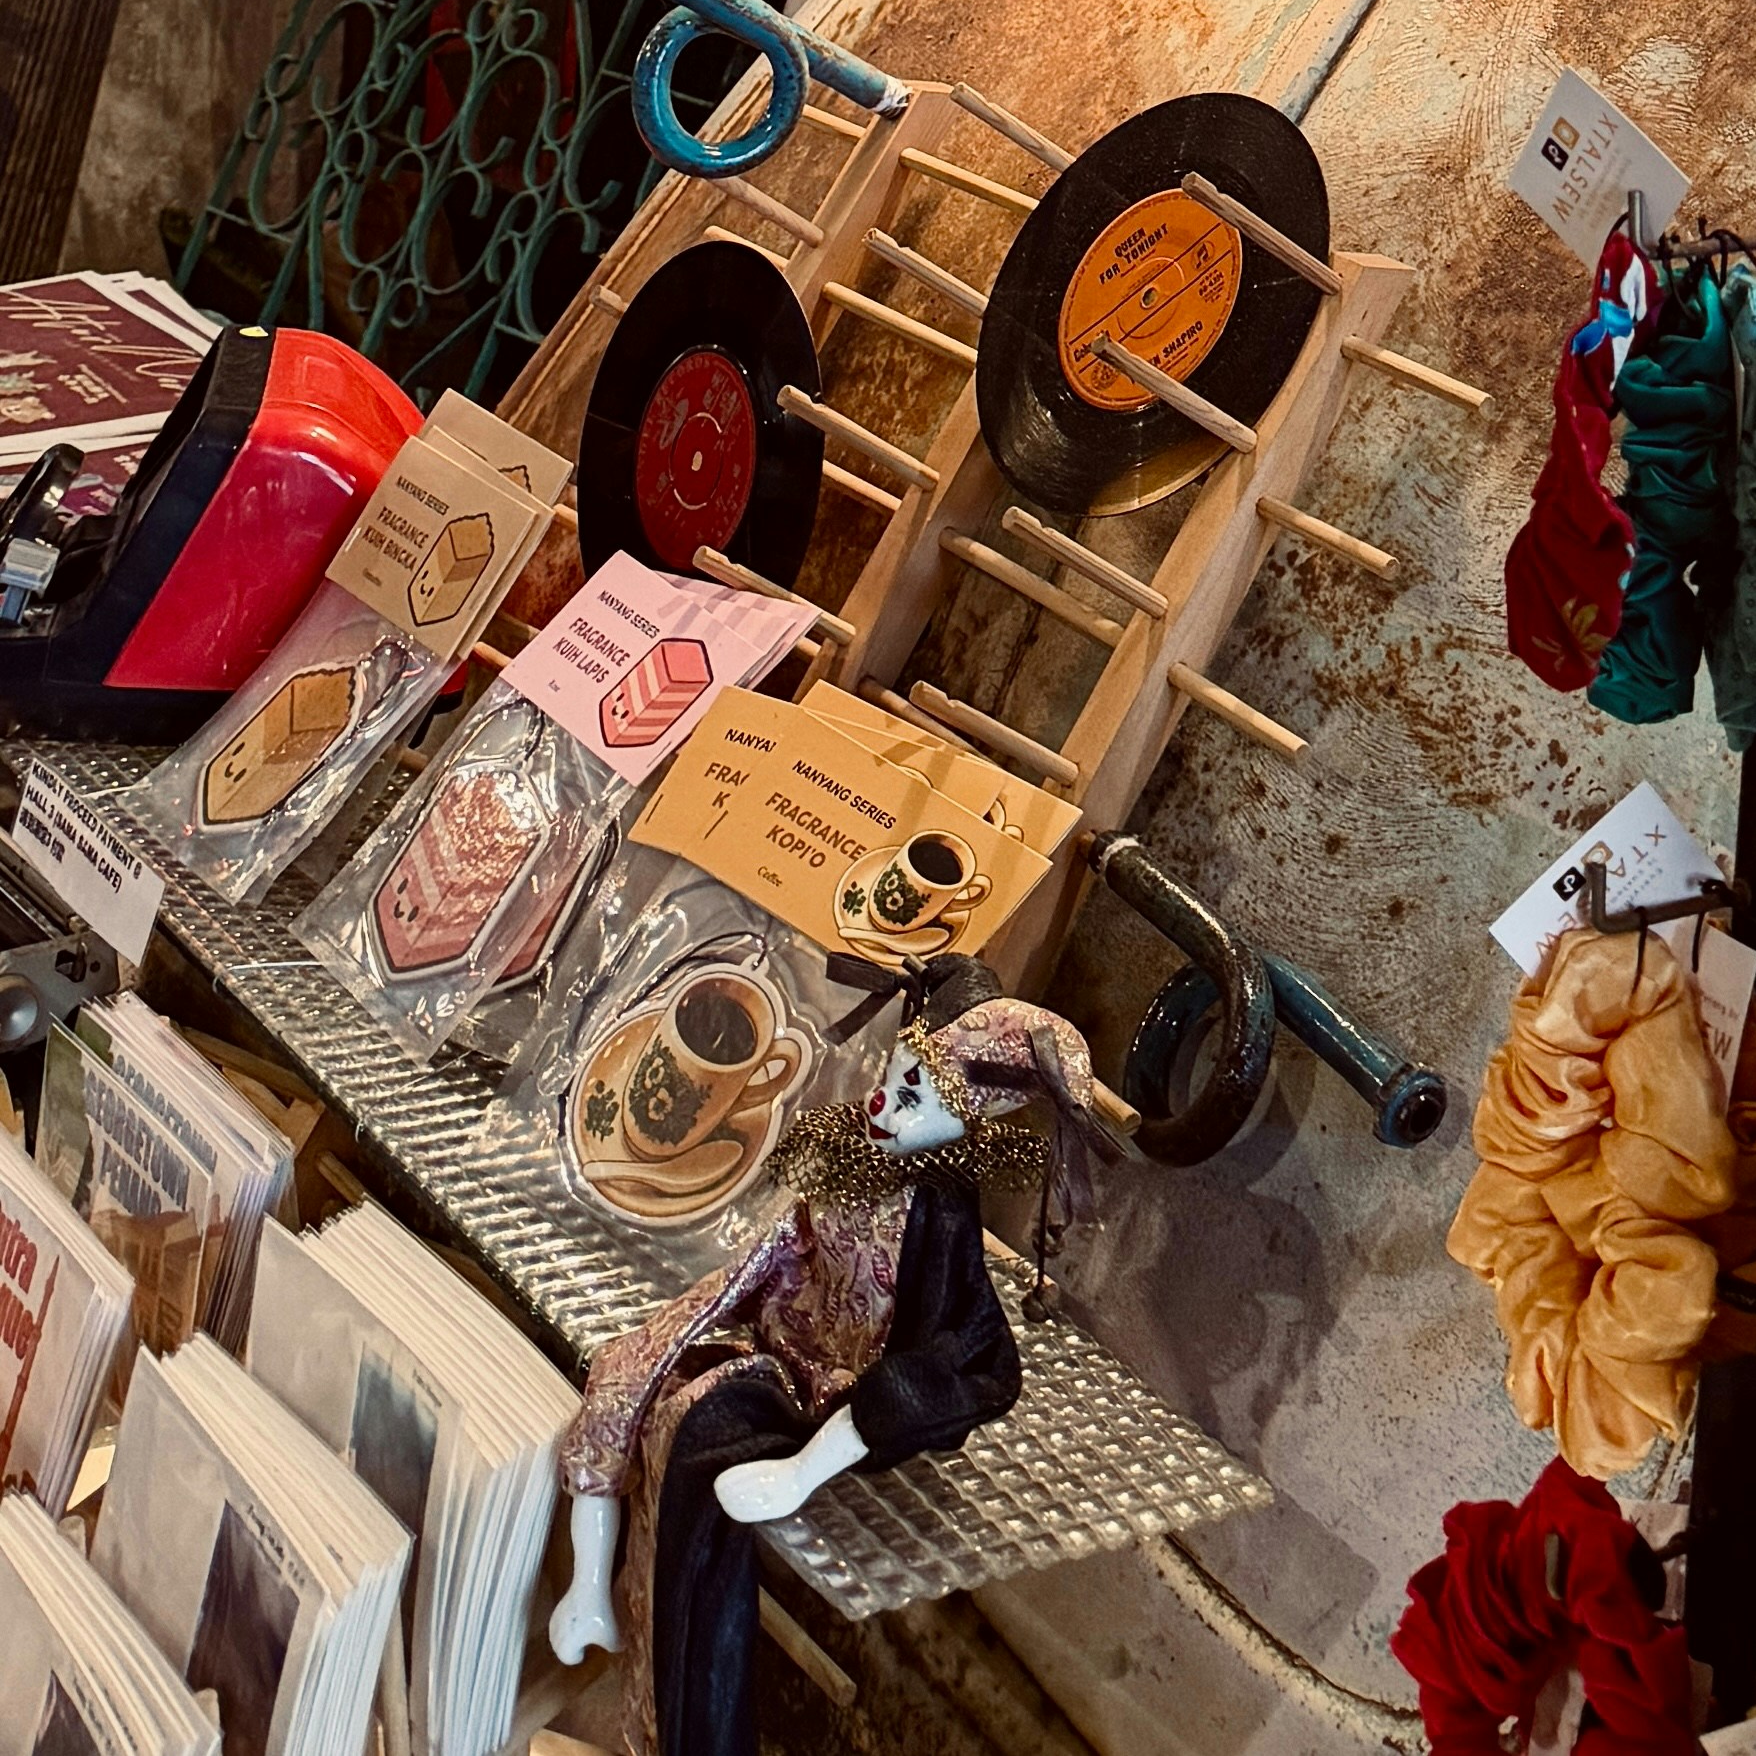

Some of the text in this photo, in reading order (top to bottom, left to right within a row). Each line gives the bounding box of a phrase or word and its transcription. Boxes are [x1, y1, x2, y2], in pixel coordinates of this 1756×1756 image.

[1551, 111, 1620, 225] XTALSEW
[1099, 222, 1169, 285] FOR TONIGHT
[1114, 227, 1148, 259] QUEEN
[1162, 319, 1204, 359] SHAPIRO
[376, 505, 430, 550] FRAGRANCE
[568, 616, 631, 668] FRAGRANCE
[597, 589, 661, 639] NANYANG SERIES
[552, 636, 610, 684] KUIH LAPIS
[32, 761, 64, 798] KINDLY
[63, 789, 98, 833] PROCEED
[96, 823, 136, 871] PAYMENT
[791, 759, 898, 830] NANYANG SERIES
[25, 784, 48, 813] HALL
[76, 835, 99, 868] SAMA
[97, 857, 123, 894] CAFE)
[764, 791, 868, 861] FRAGRANCE
[765, 824, 827, 869] KOPI'O
[1535, 823, 1668, 961] XTAEW
